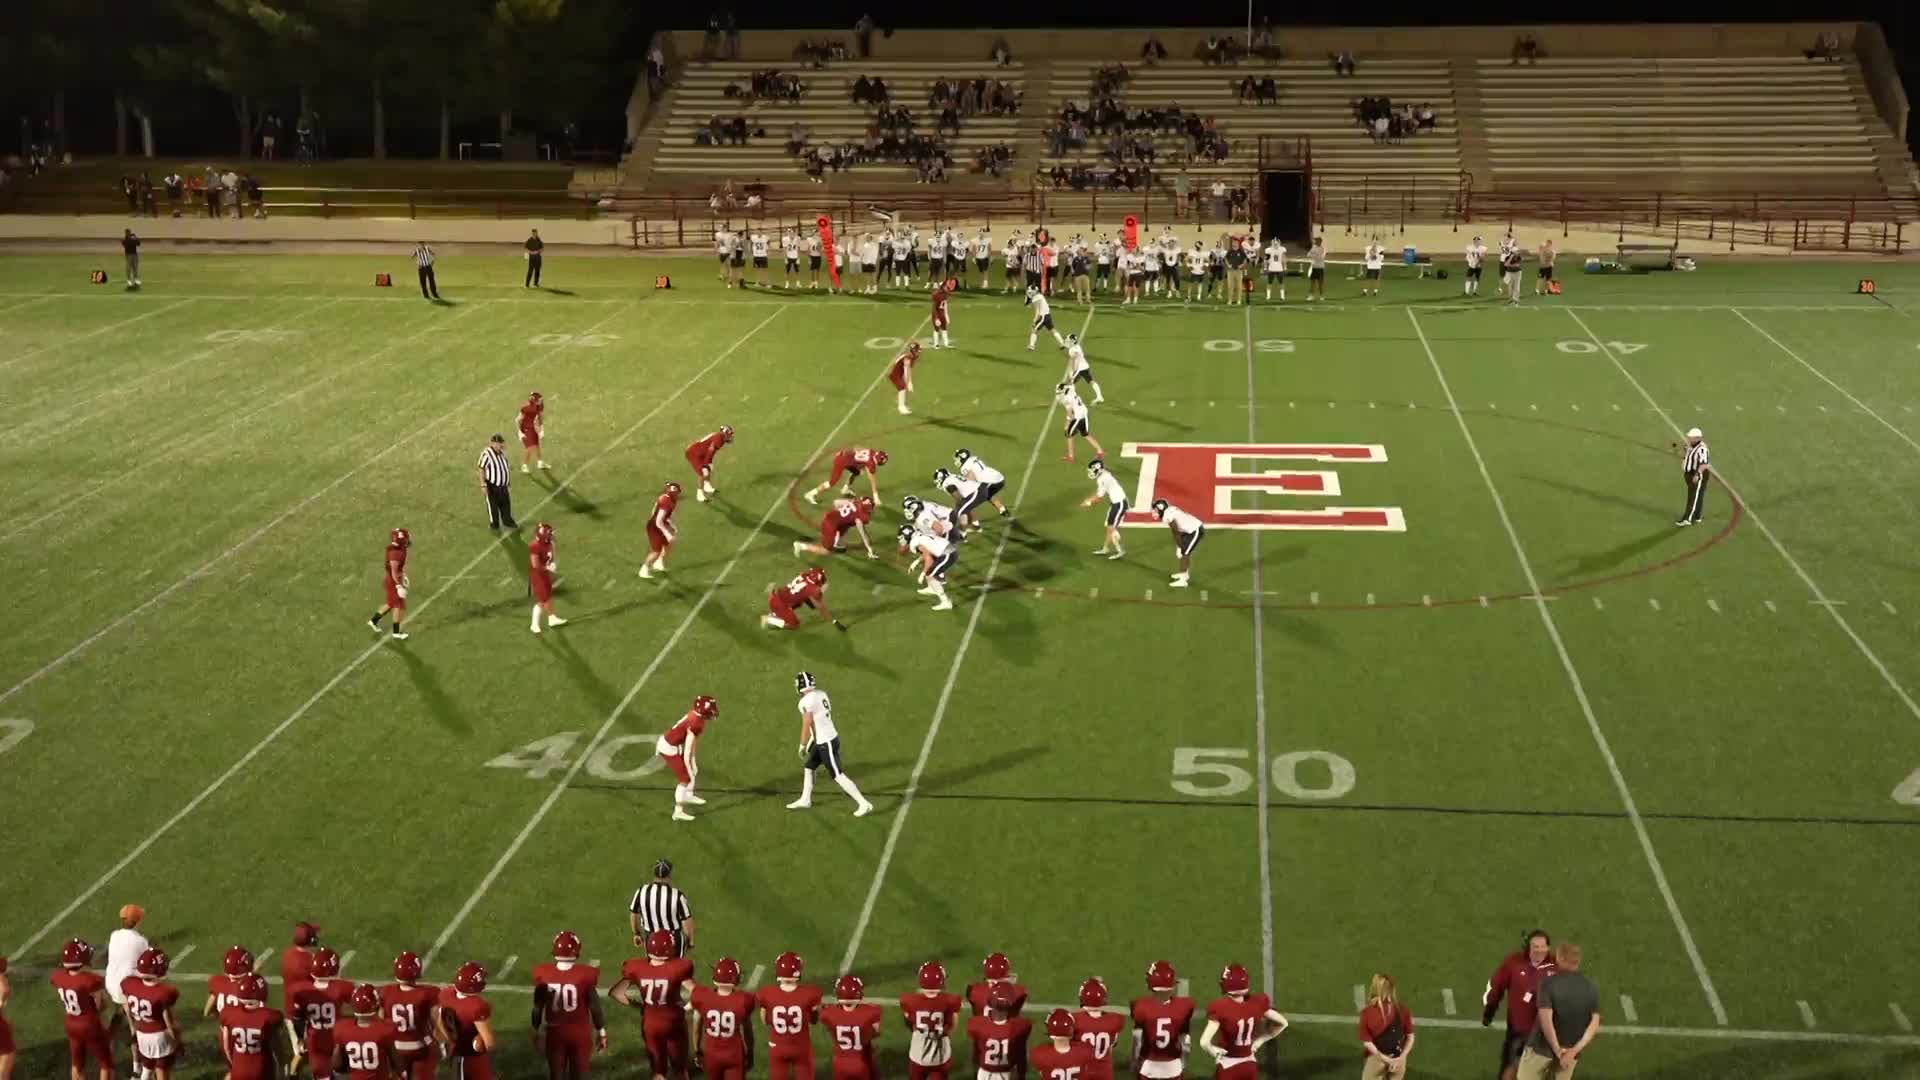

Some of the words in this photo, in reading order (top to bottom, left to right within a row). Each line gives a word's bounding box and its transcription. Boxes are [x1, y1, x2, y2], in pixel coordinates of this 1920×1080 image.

[1105, 442, 1407, 532] E
[483, 731, 674, 781] 40
[1170, 747, 1356, 799] 50
[58, 988, 81, 1016] 18
[547, 983, 577, 1012] 70
[640, 979, 669, 1006] 77
[706, 1009, 736, 1038] 39
[772, 1005, 802, 1034] 63
[916, 1010, 944, 1038] 53
[1156, 1018, 1171, 1049] 5
[1236, 1017, 1254, 1047] 11
[231, 1027, 261, 1053] 35
[836, 1026, 863, 1050] 51
[985, 1038, 1008, 1065] 21
[345, 1041, 379, 1070] 20
